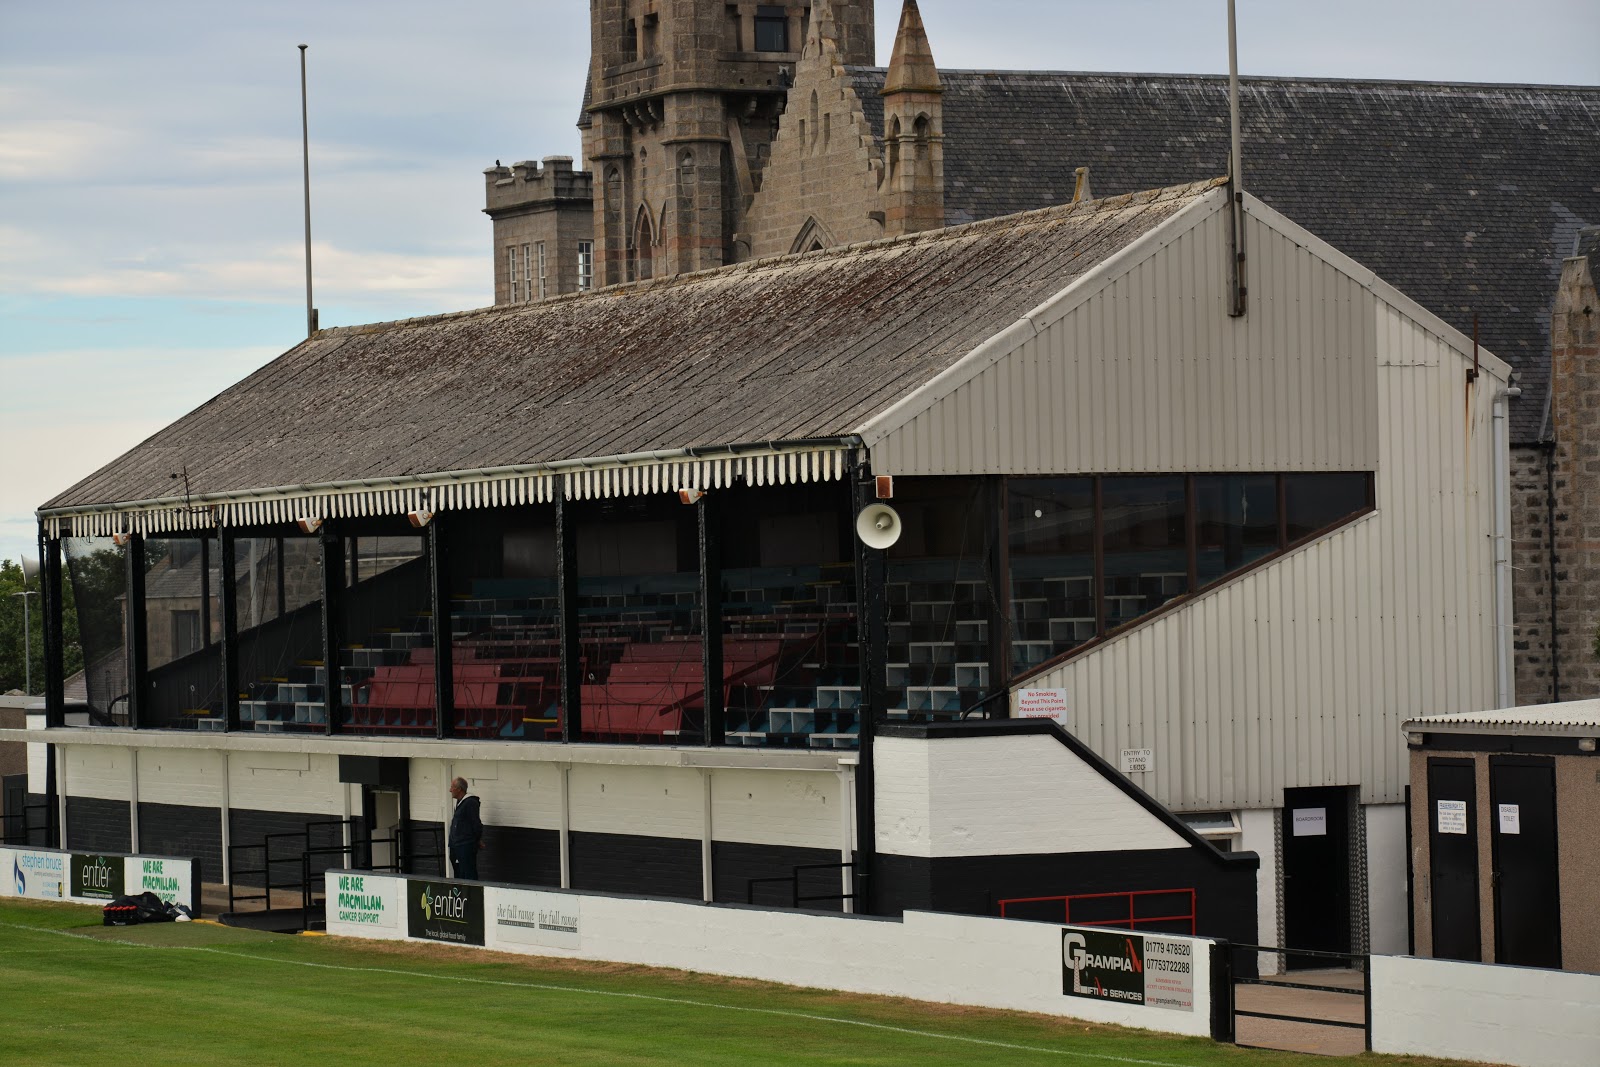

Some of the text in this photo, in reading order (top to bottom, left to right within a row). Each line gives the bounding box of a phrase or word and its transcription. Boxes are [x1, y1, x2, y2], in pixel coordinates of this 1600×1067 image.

[22, 852, 62, 871] stephen bruce
[142, 860, 163, 874] WE ARE
[82, 858, 112, 888] entier
[339, 876, 363, 892] WE ARE
[339, 893, 384, 911] MACMILLAN.
[435, 888, 467, 918] entier
[339, 911, 379, 923] CANCER SUPPORT
[497, 904, 534, 922] the full range
[539, 910, 578, 927] the full range
[1064, 933, 1142, 973] GRAMPIAN
[1146, 941, 1190, 956] 01779 478520
[1147, 959, 1190, 973] 07753722288
[1110, 989, 1142, 1001] SERVICES
